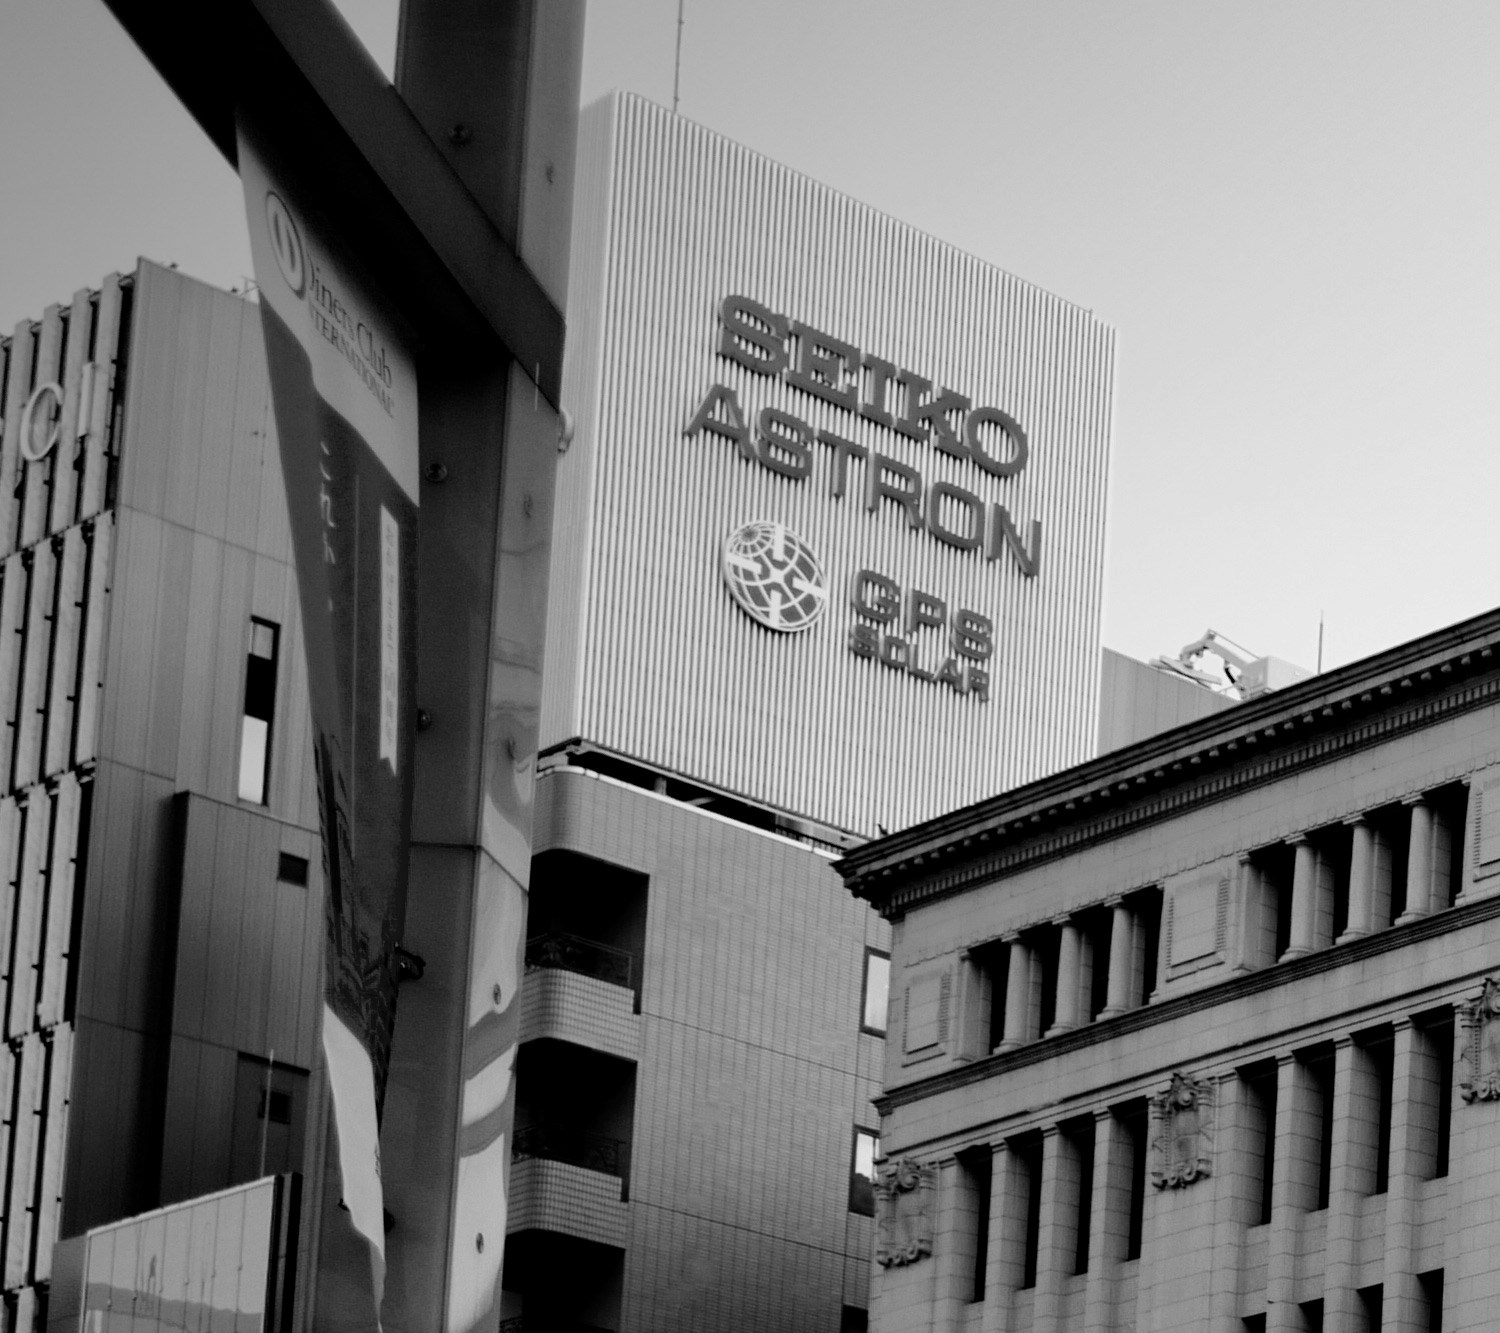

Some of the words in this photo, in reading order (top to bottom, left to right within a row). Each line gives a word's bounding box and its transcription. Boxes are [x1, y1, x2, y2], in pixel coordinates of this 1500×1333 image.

[716, 294, 1029, 479] SEIKO
[683, 383, 1042, 579] ASTRON
[849, 623, 990, 703] SOLAR
[851, 568, 993, 662] GPS
